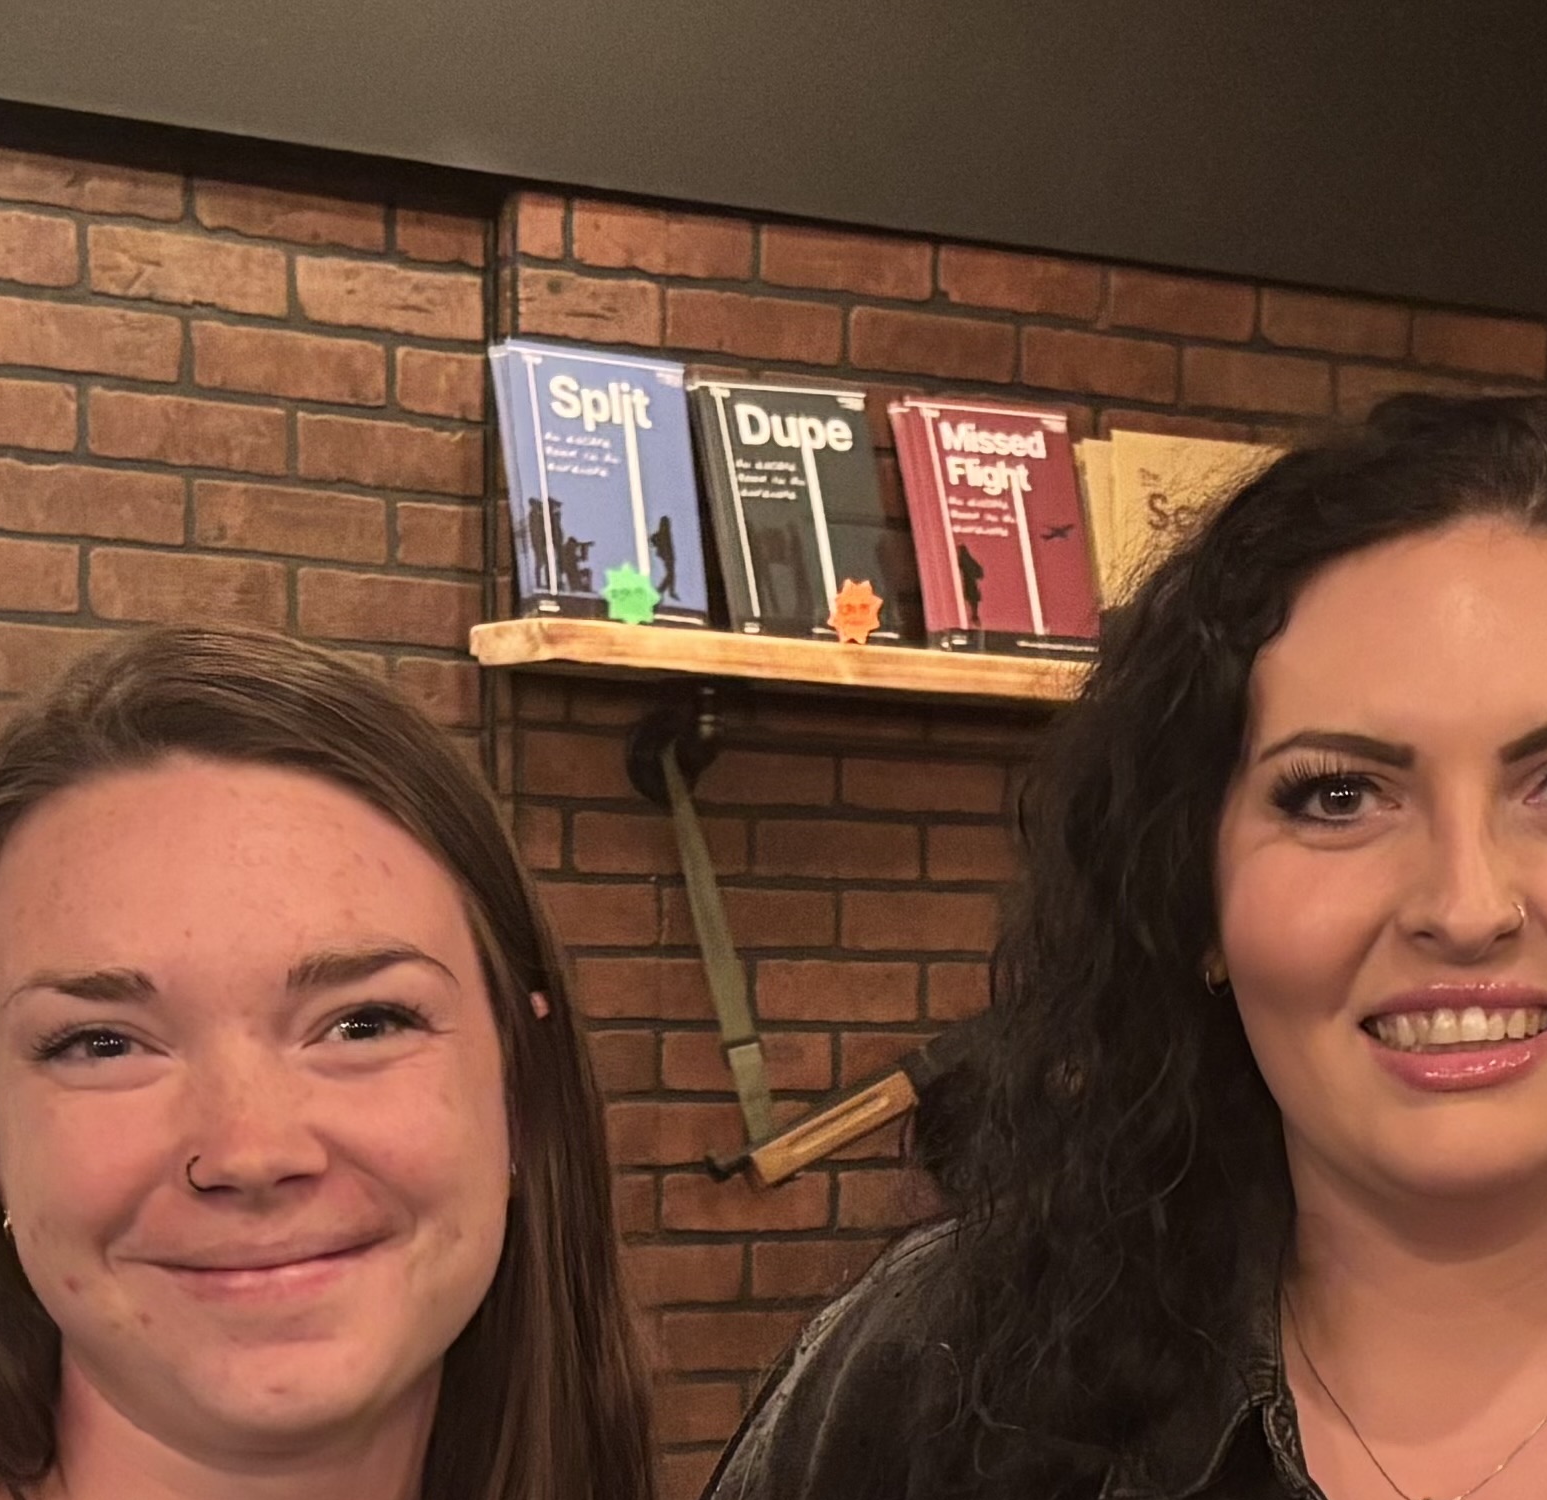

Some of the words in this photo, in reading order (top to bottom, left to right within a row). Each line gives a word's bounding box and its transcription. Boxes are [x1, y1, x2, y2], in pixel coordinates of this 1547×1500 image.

[549, 375, 652, 432] Split
[734, 403, 853, 454] Dupe
[938, 421, 1047, 459] Missed
[945, 456, 1032, 496] Flight
